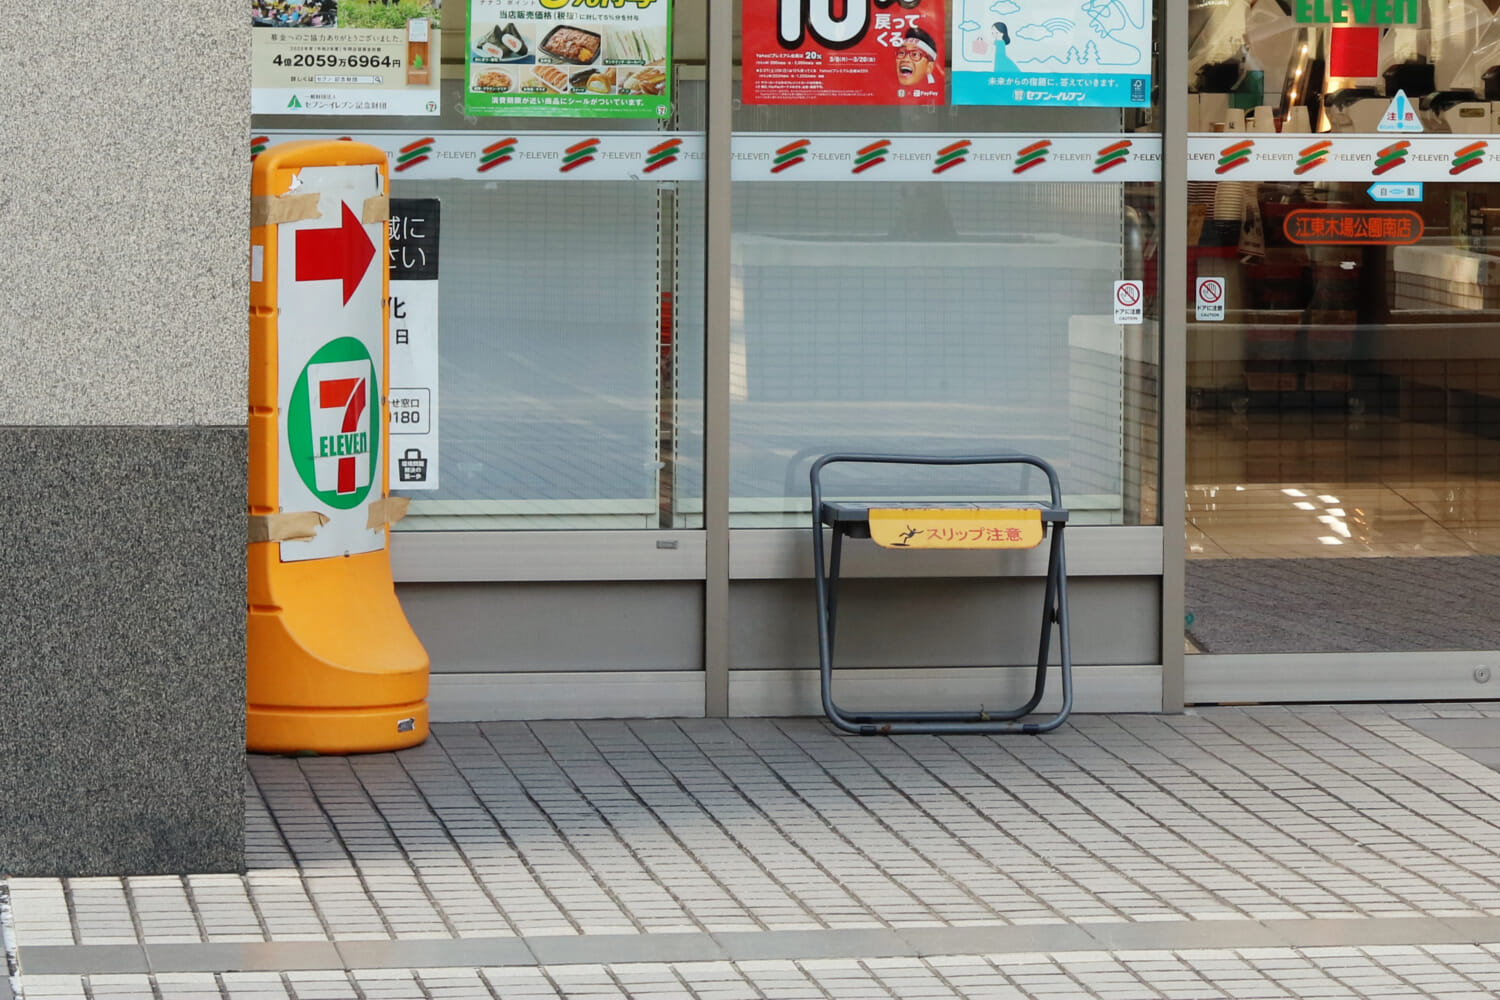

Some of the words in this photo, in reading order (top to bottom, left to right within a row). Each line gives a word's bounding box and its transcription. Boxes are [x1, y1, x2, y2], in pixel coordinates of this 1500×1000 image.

[874, 13, 920, 30] 戻って
[272, 54, 401, 69] 4億2059万6964円
[1294, 216, 1413, 239] 江東木場公園南店
[926, 527, 1024, 542] スリップ注意
